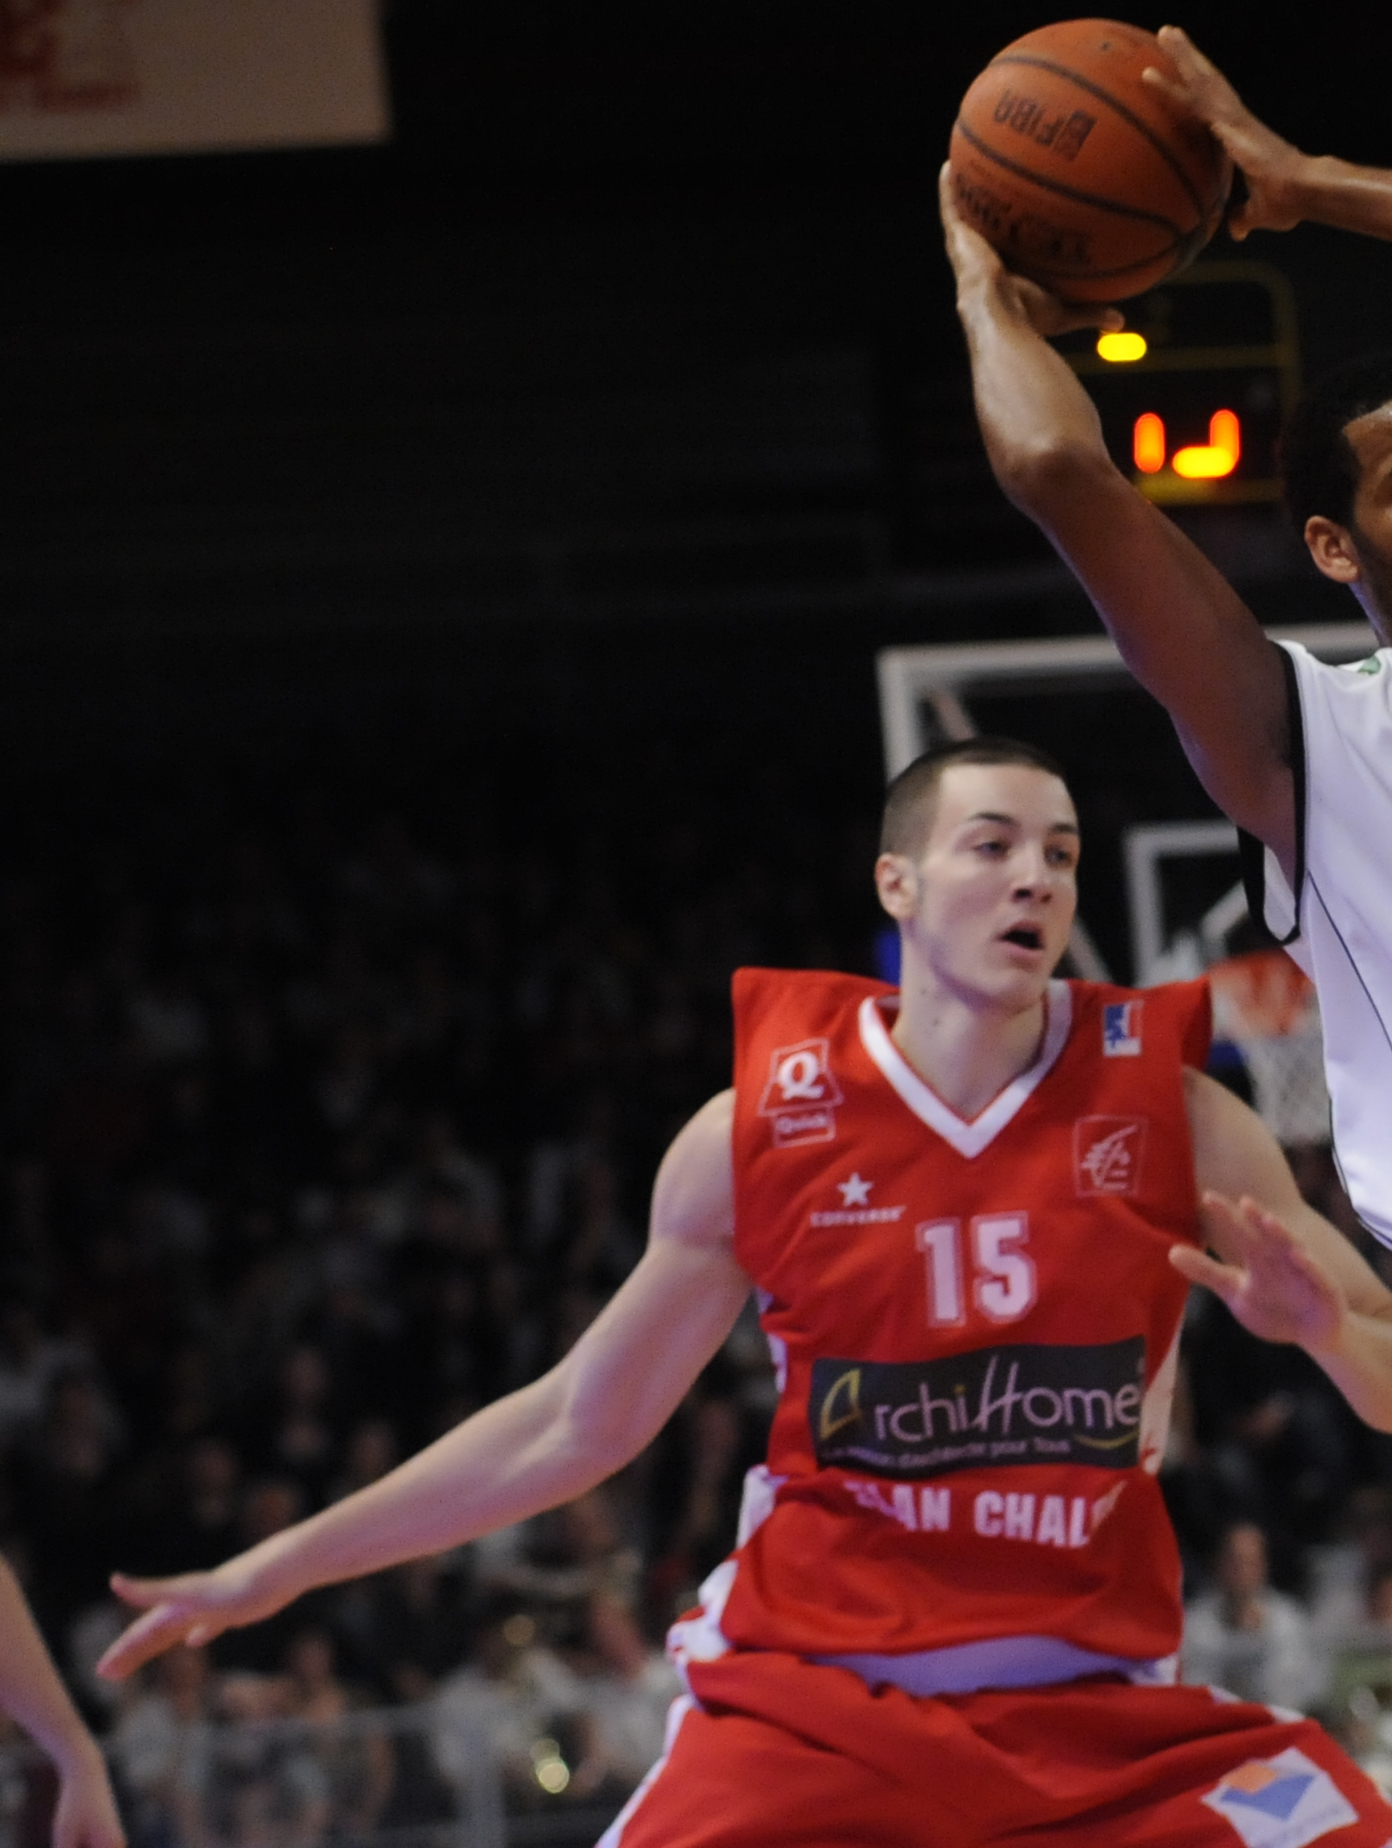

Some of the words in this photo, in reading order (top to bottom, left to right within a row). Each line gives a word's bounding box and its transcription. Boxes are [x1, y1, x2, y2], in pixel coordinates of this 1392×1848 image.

[777, 1051, 825, 1100] Q
[915, 1211, 1037, 1329] 15
[820, 1356, 1142, 1442] ArchiHome
